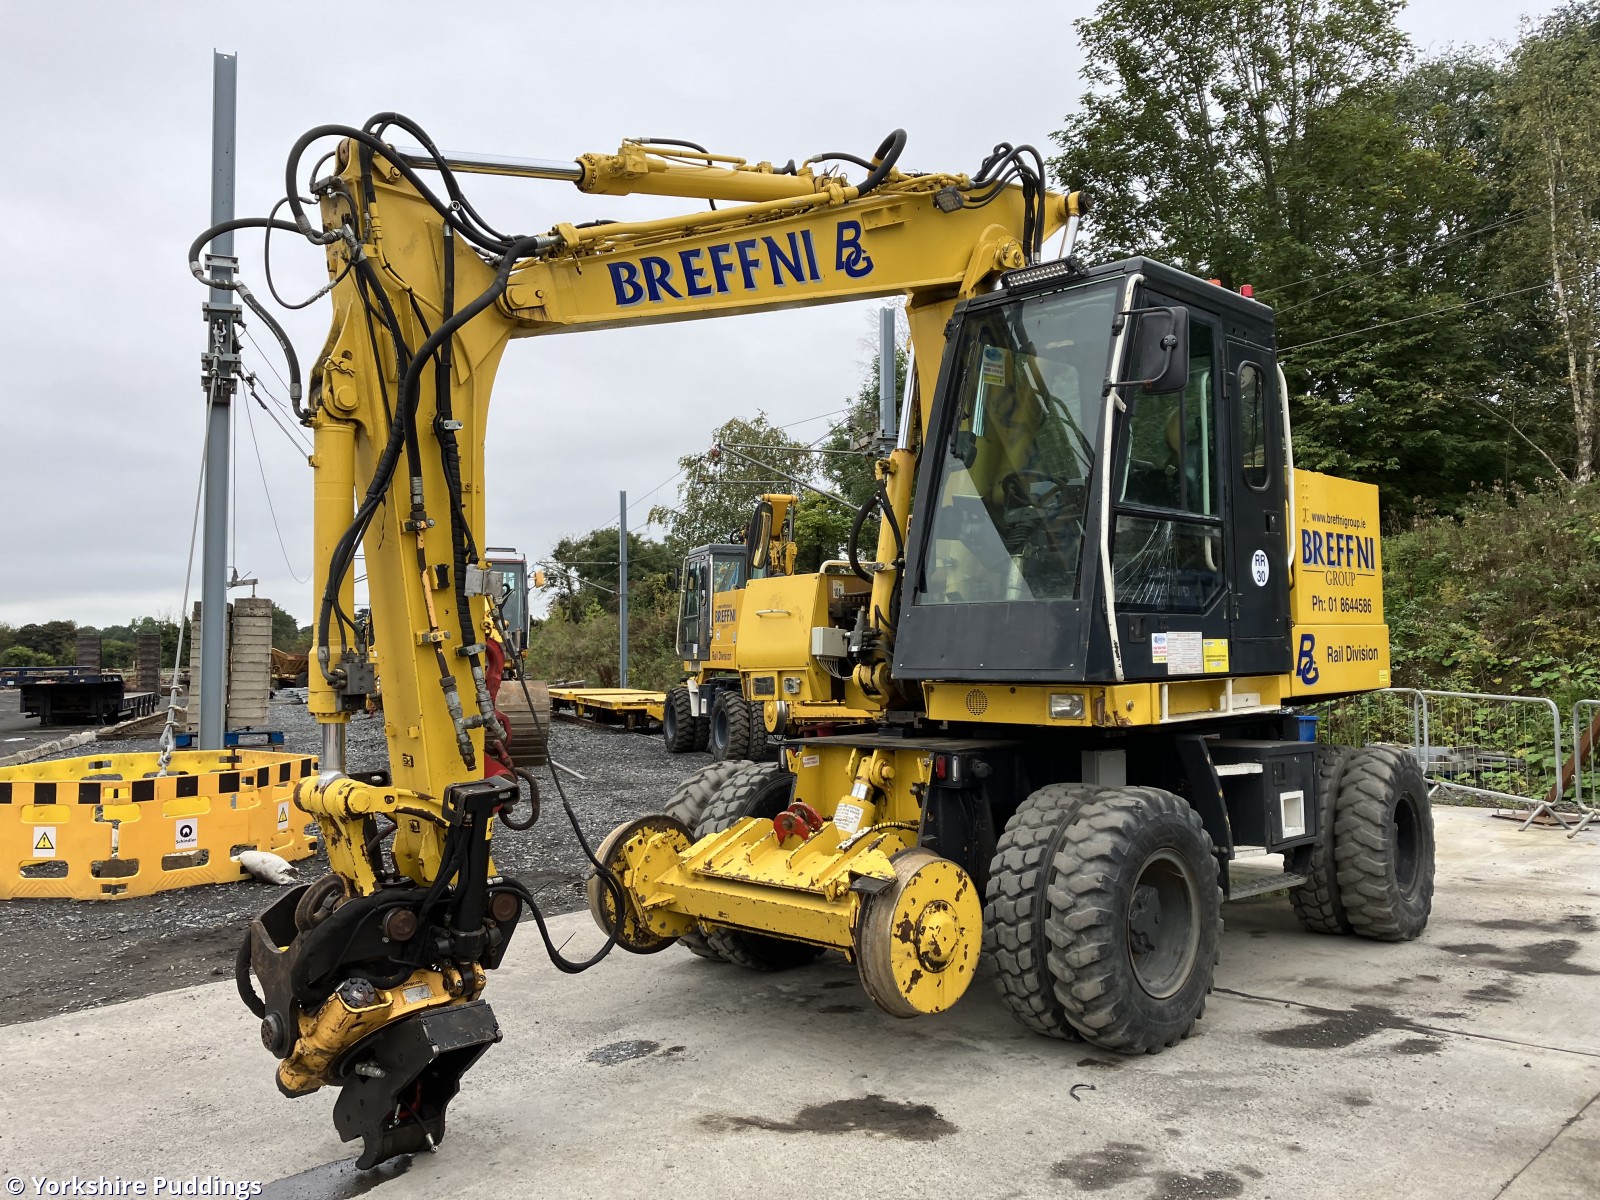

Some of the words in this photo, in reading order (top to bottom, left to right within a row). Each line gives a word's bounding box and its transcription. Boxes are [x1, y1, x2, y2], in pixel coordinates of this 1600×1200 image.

[607, 229, 822, 306] BREFFNI
[1312, 513, 1366, 530] www.breffnigroup.ie
[1301, 529, 1376, 570] BREFFNI
[1255, 554, 1266, 566] RR
[1256, 570, 1266, 582] 30
[1325, 570, 1355, 586] GROUP
[1312, 595, 1326, 611] Ph:
[1328, 597, 1338, 612] 01
[1340, 598, 1372, 613] 8644586
[1327, 646, 1344, 663] Rail
[1346, 645, 1379, 662] Division
